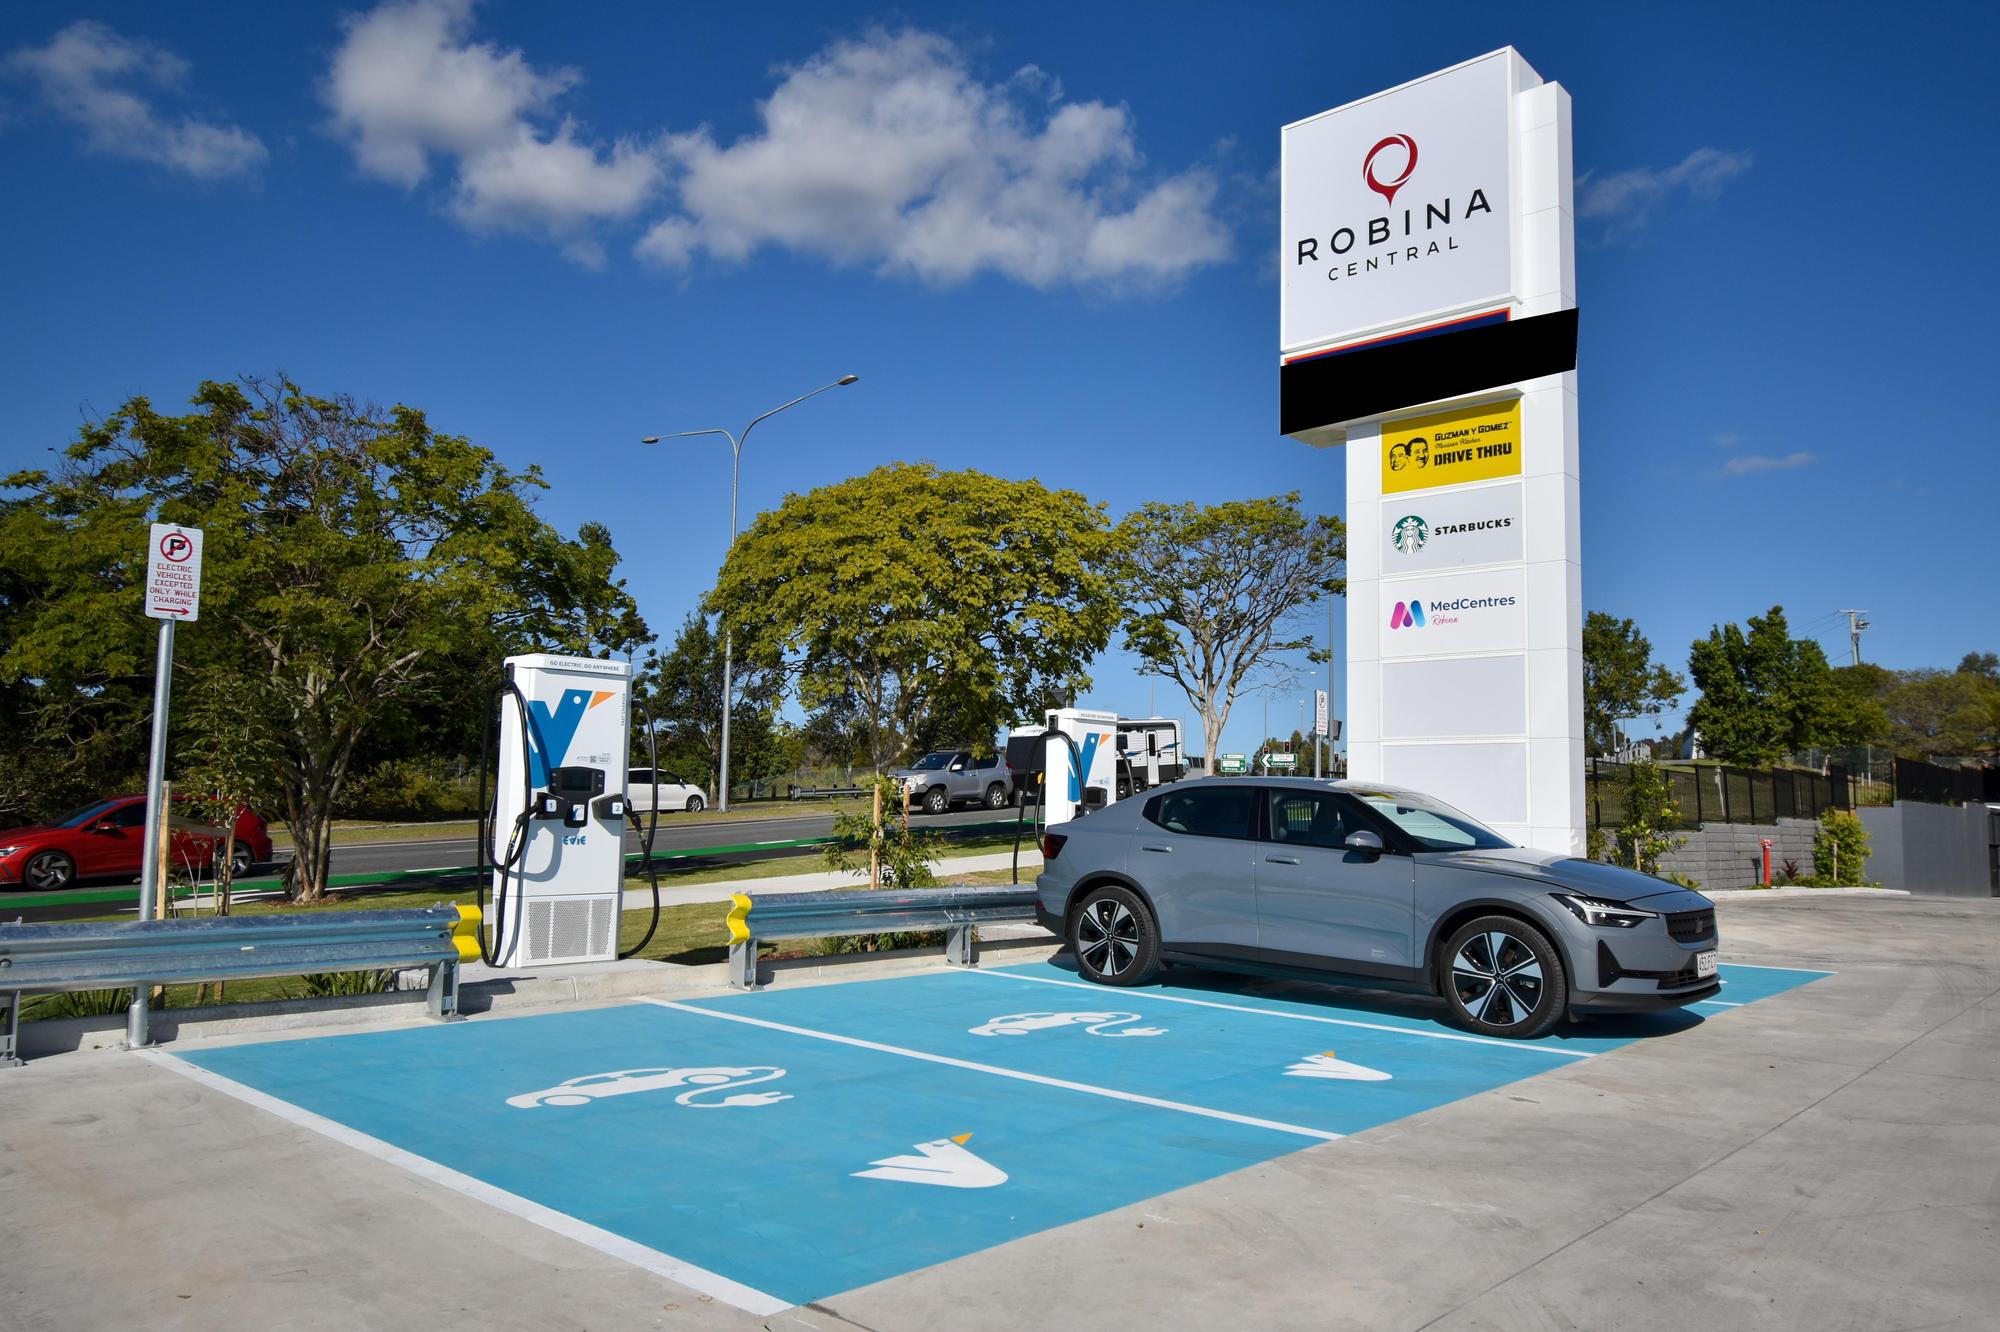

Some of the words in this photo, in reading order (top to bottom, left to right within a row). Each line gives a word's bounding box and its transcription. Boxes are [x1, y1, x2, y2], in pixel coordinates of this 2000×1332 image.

[1298, 188, 1492, 266] ROBINA
[1328, 235, 1459, 281] CENTRAL
[1435, 428, 1469, 442] GUZMAN
[1471, 427, 1477, 435] Y
[1478, 422, 1509, 434] GOMEZ
[1434, 448, 1473, 466] DRIVE
[1476, 442, 1512, 459] THRU
[1434, 518, 1511, 536] STARBUCKS
[156, 563, 192, 573] ELECTRIC
[156, 571, 192, 581] VEHICLES
[149, 587, 171, 595] ONLY
[174, 589, 197, 598] WHILE
[155, 580, 193, 589] EXCEPTED
[153, 596, 192, 606] CHARGING
[1430, 596, 1516, 612] MedCentres
